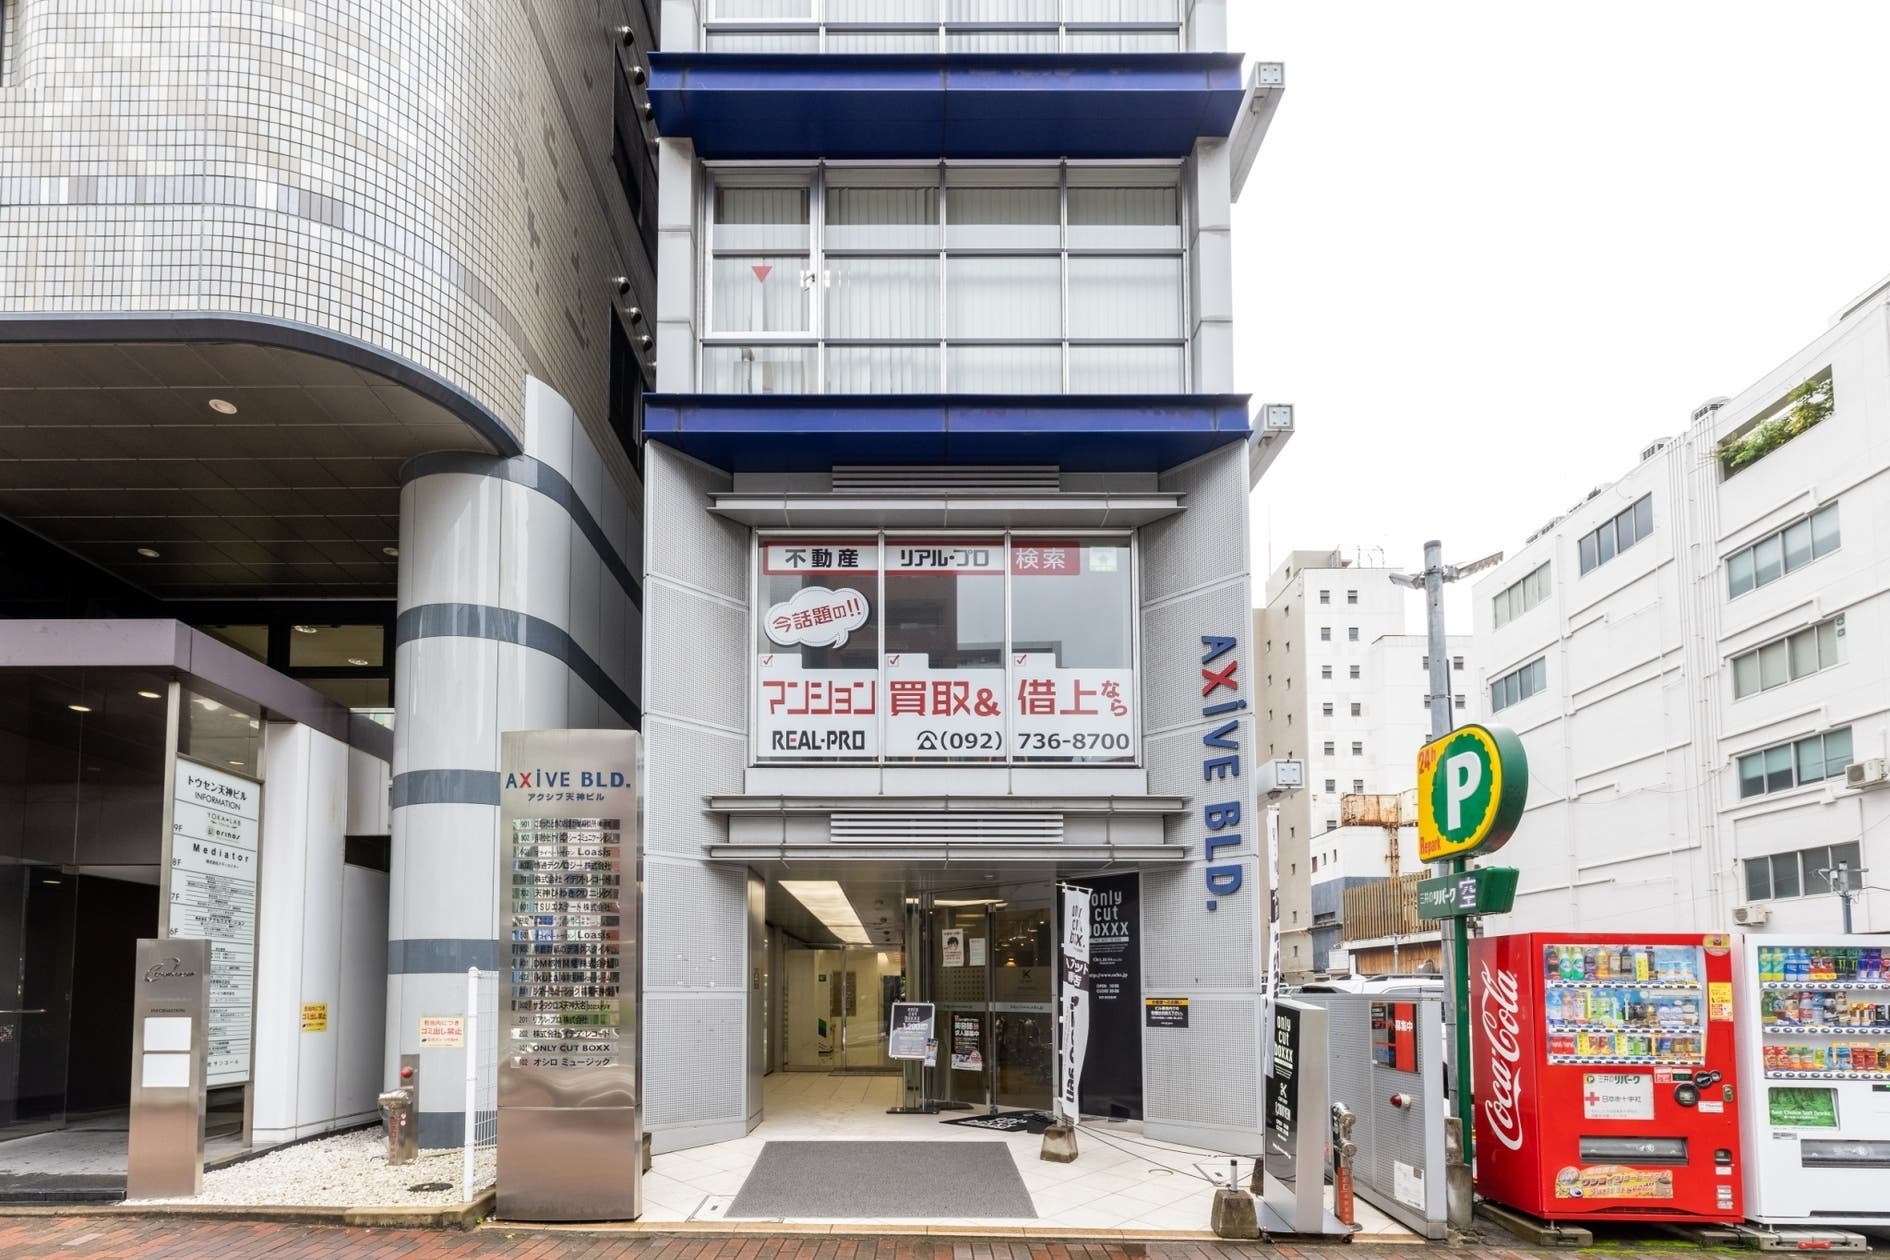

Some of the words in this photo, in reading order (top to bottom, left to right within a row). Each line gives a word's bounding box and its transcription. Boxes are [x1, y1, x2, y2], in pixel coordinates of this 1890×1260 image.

[785, 548, 859, 568] 不動産
[1016, 548, 1065, 569] 検索
[772, 598, 862, 633] 今話題の!!
[762, 680, 876, 715] マンション
[890, 680, 1001, 717] 買取&
[941, 731, 1003, 750] (092)
[1018, 733, 1130, 750] 736-8700
[188, 775, 247, 801] トウセン天神ビル
[581, 771, 631, 788] BLD.
[1446, 751, 1482, 831] P
[194, 791, 241, 811] INFORMATION
[193, 843, 249, 863] Mediator
[1204, 801, 1242, 910] BLD.
[1091, 889, 1122, 906] only
[1459, 877, 1476, 908] 空
[1094, 905, 1119, 922] cut
[421, 1027, 463, 1036] ゴミ出し禁止
[1276, 1015, 1292, 1032] only
[533, 1030, 562, 1039] 株式会社
[1278, 1031, 1290, 1047] cut
[533, 1044, 557, 1052] ONLY
[559, 1044, 579, 1052] CUT
[582, 1044, 611, 1052] BOXX
[533, 1058, 557, 1066] オシロ
[561, 1058, 610, 1066] ミュージック
